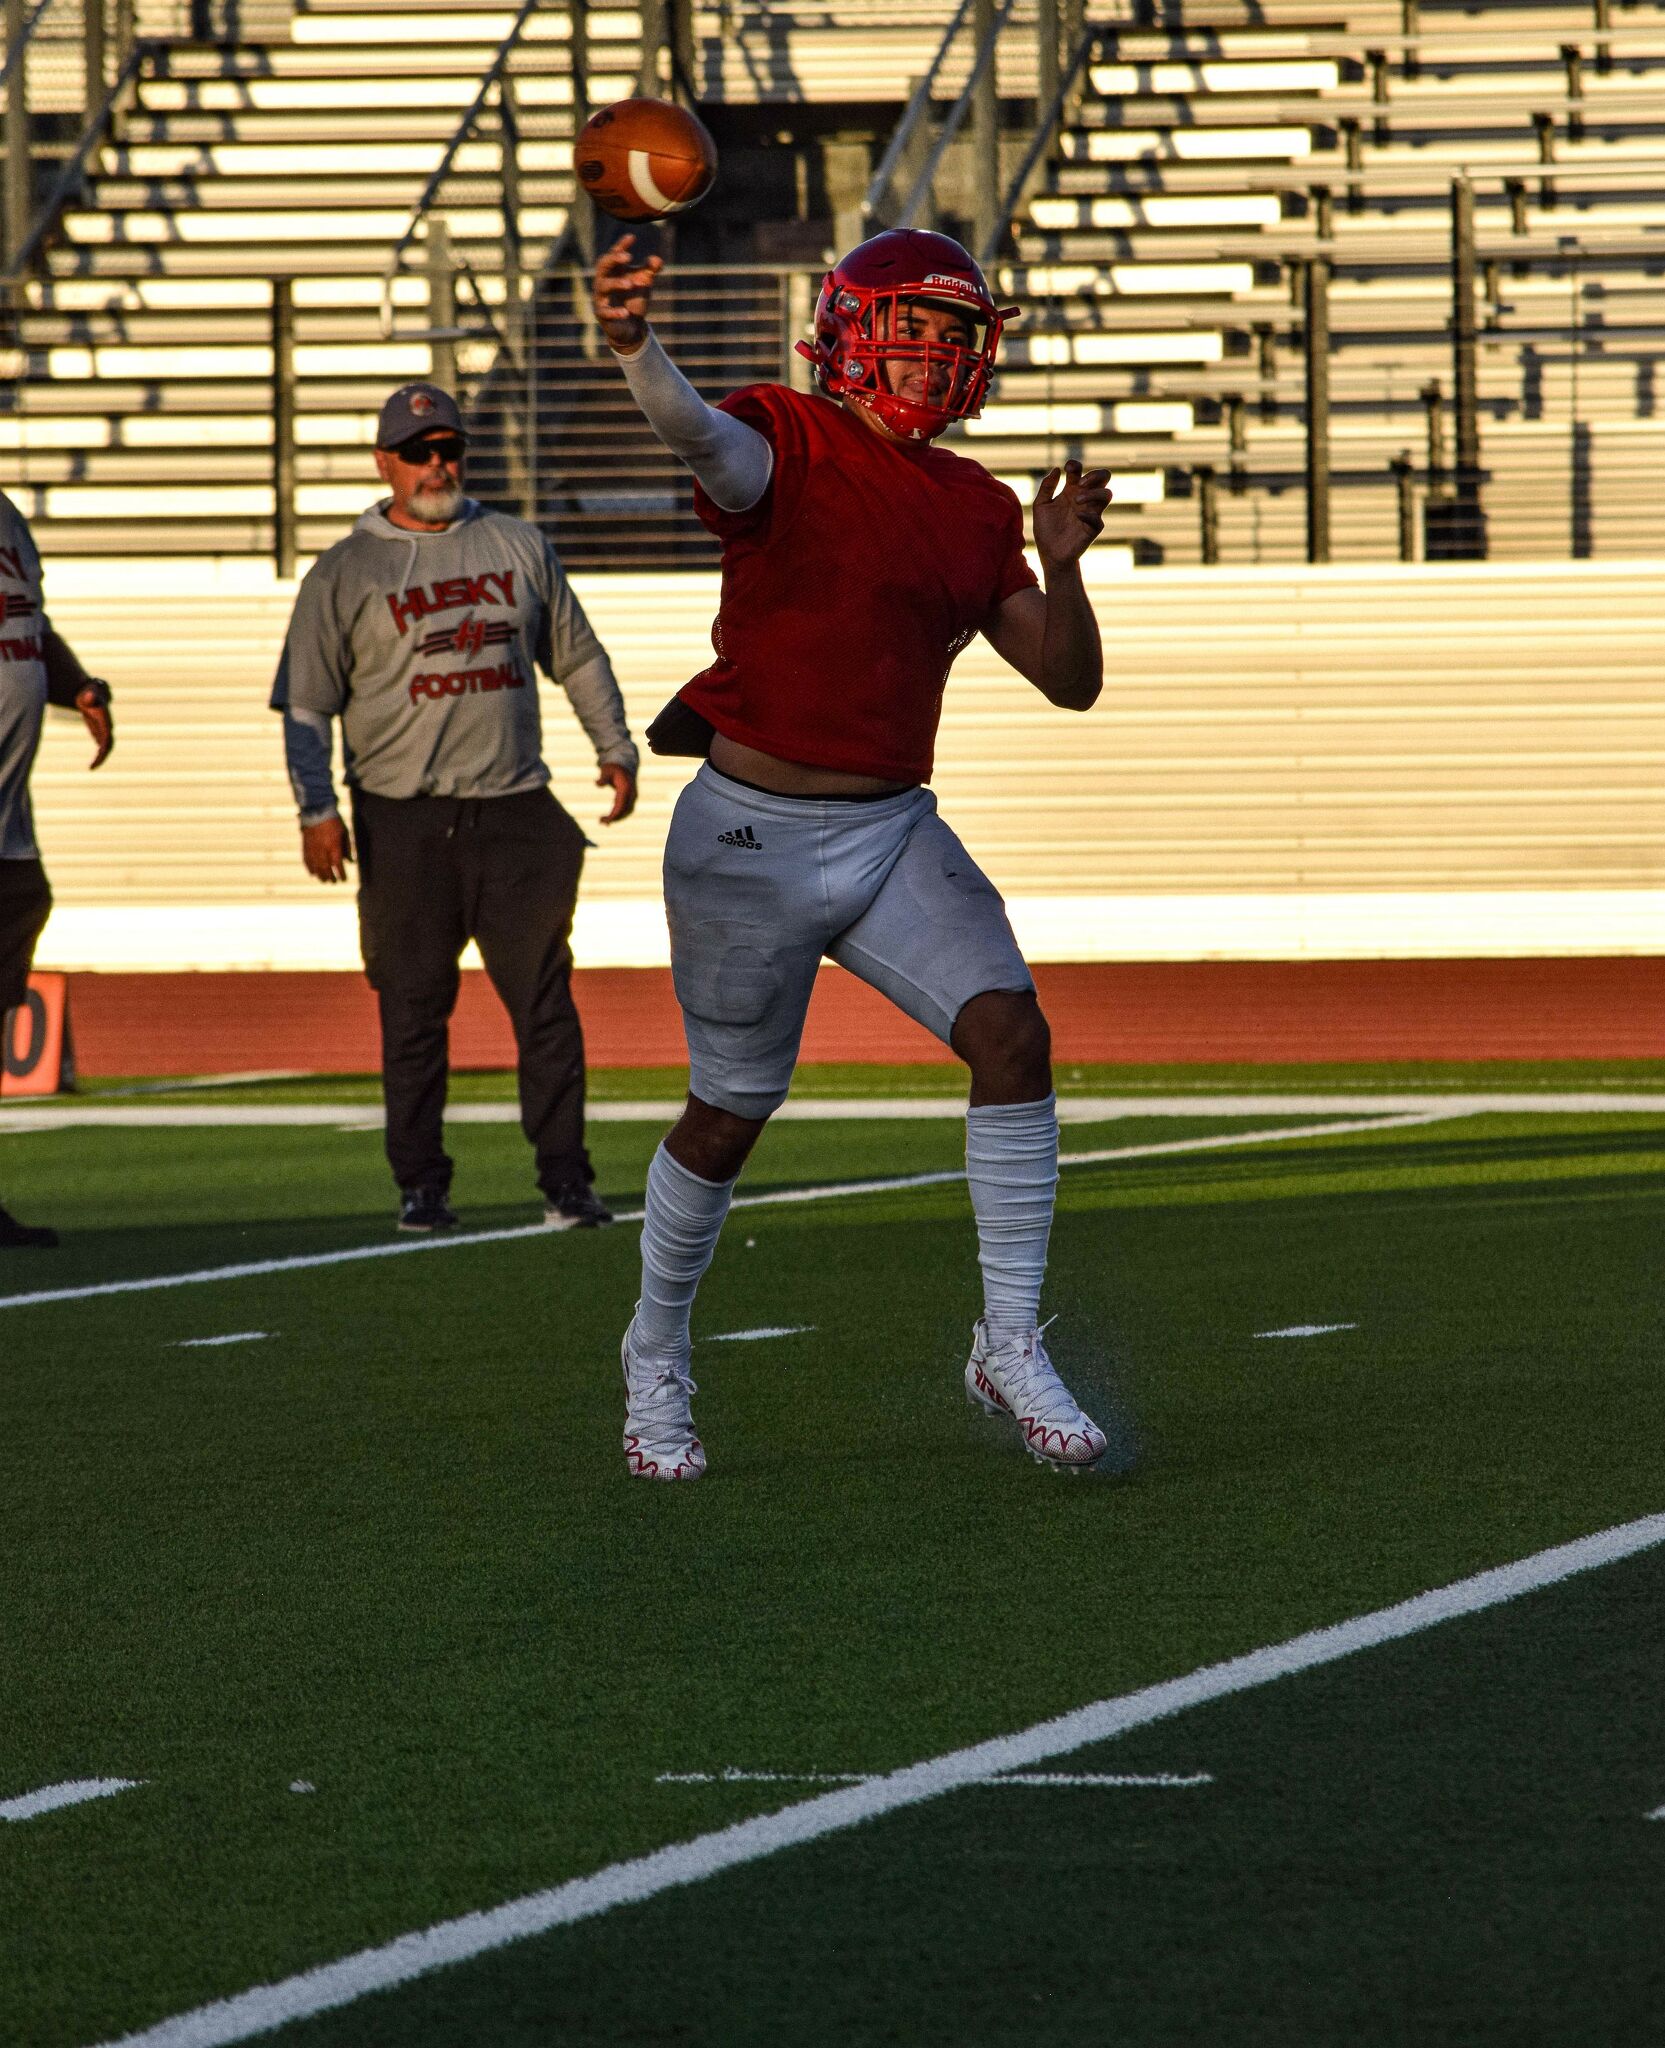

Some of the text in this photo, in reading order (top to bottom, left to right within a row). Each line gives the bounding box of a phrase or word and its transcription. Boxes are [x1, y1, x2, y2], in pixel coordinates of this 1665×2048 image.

[386, 570, 517, 637] HUSKY
[408, 660, 525, 707] FOOTBALL
[717, 834, 763, 851] adidas
